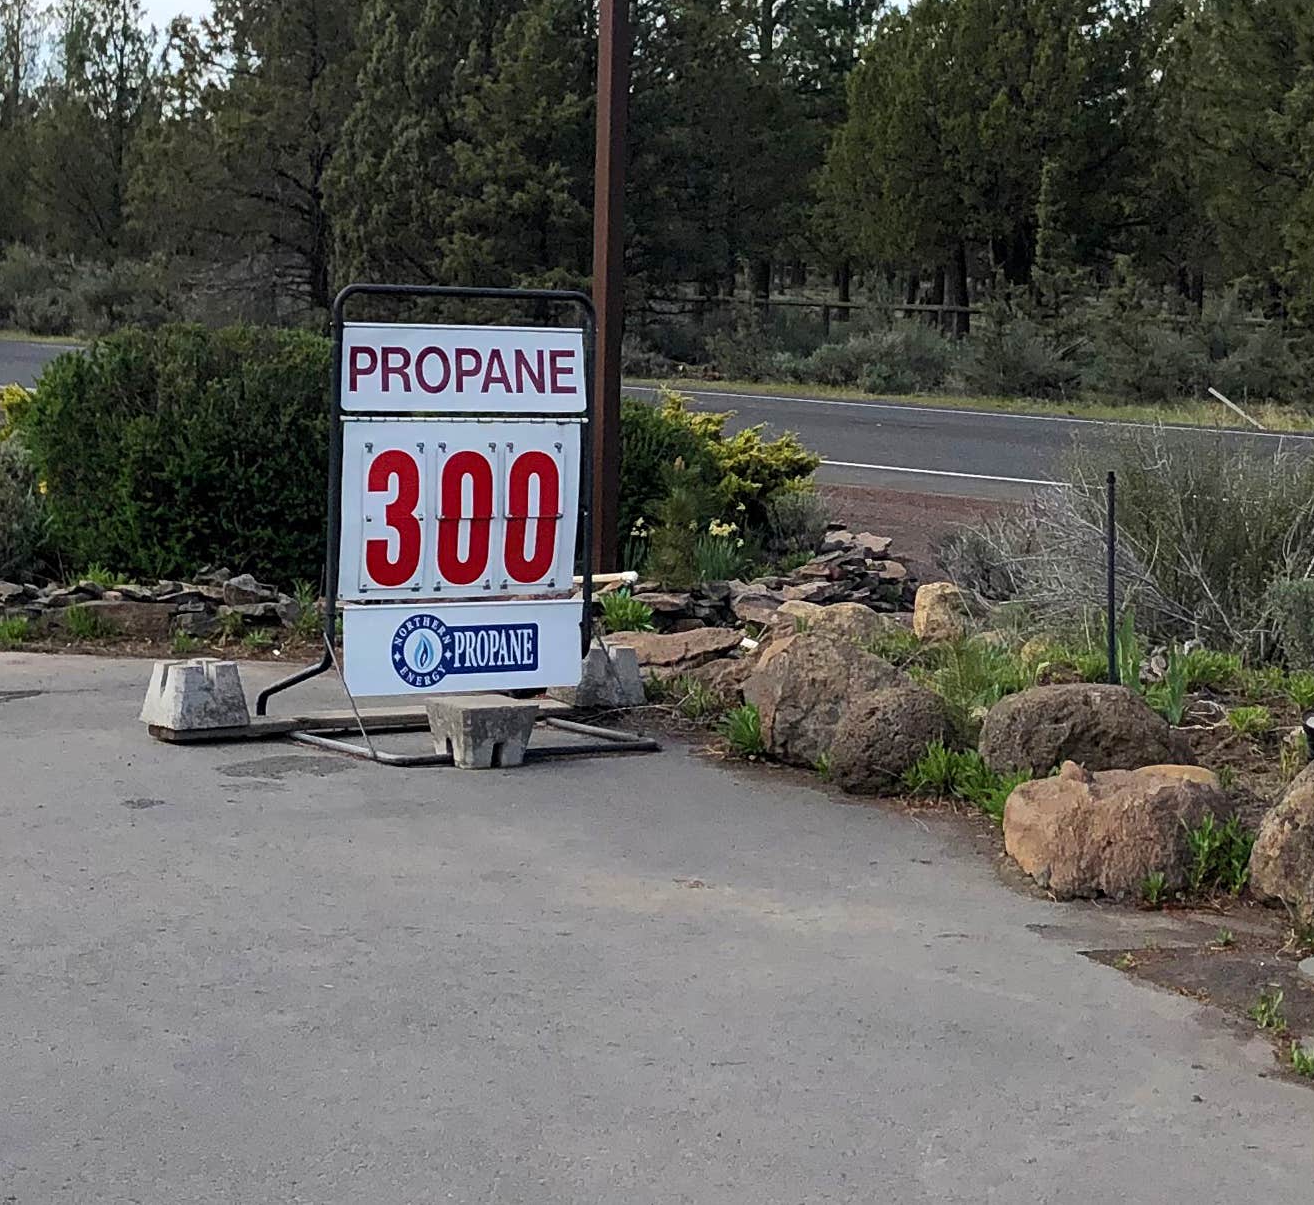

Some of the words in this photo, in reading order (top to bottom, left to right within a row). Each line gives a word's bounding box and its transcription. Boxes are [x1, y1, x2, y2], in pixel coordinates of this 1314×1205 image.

[348, 345, 578, 394] PROPANE
[365, 449, 560, 587] 300
[394, 616, 452, 646] NORTHERN
[453, 629, 534, 667] PROPANE
[399, 664, 447, 686] ENERGY
